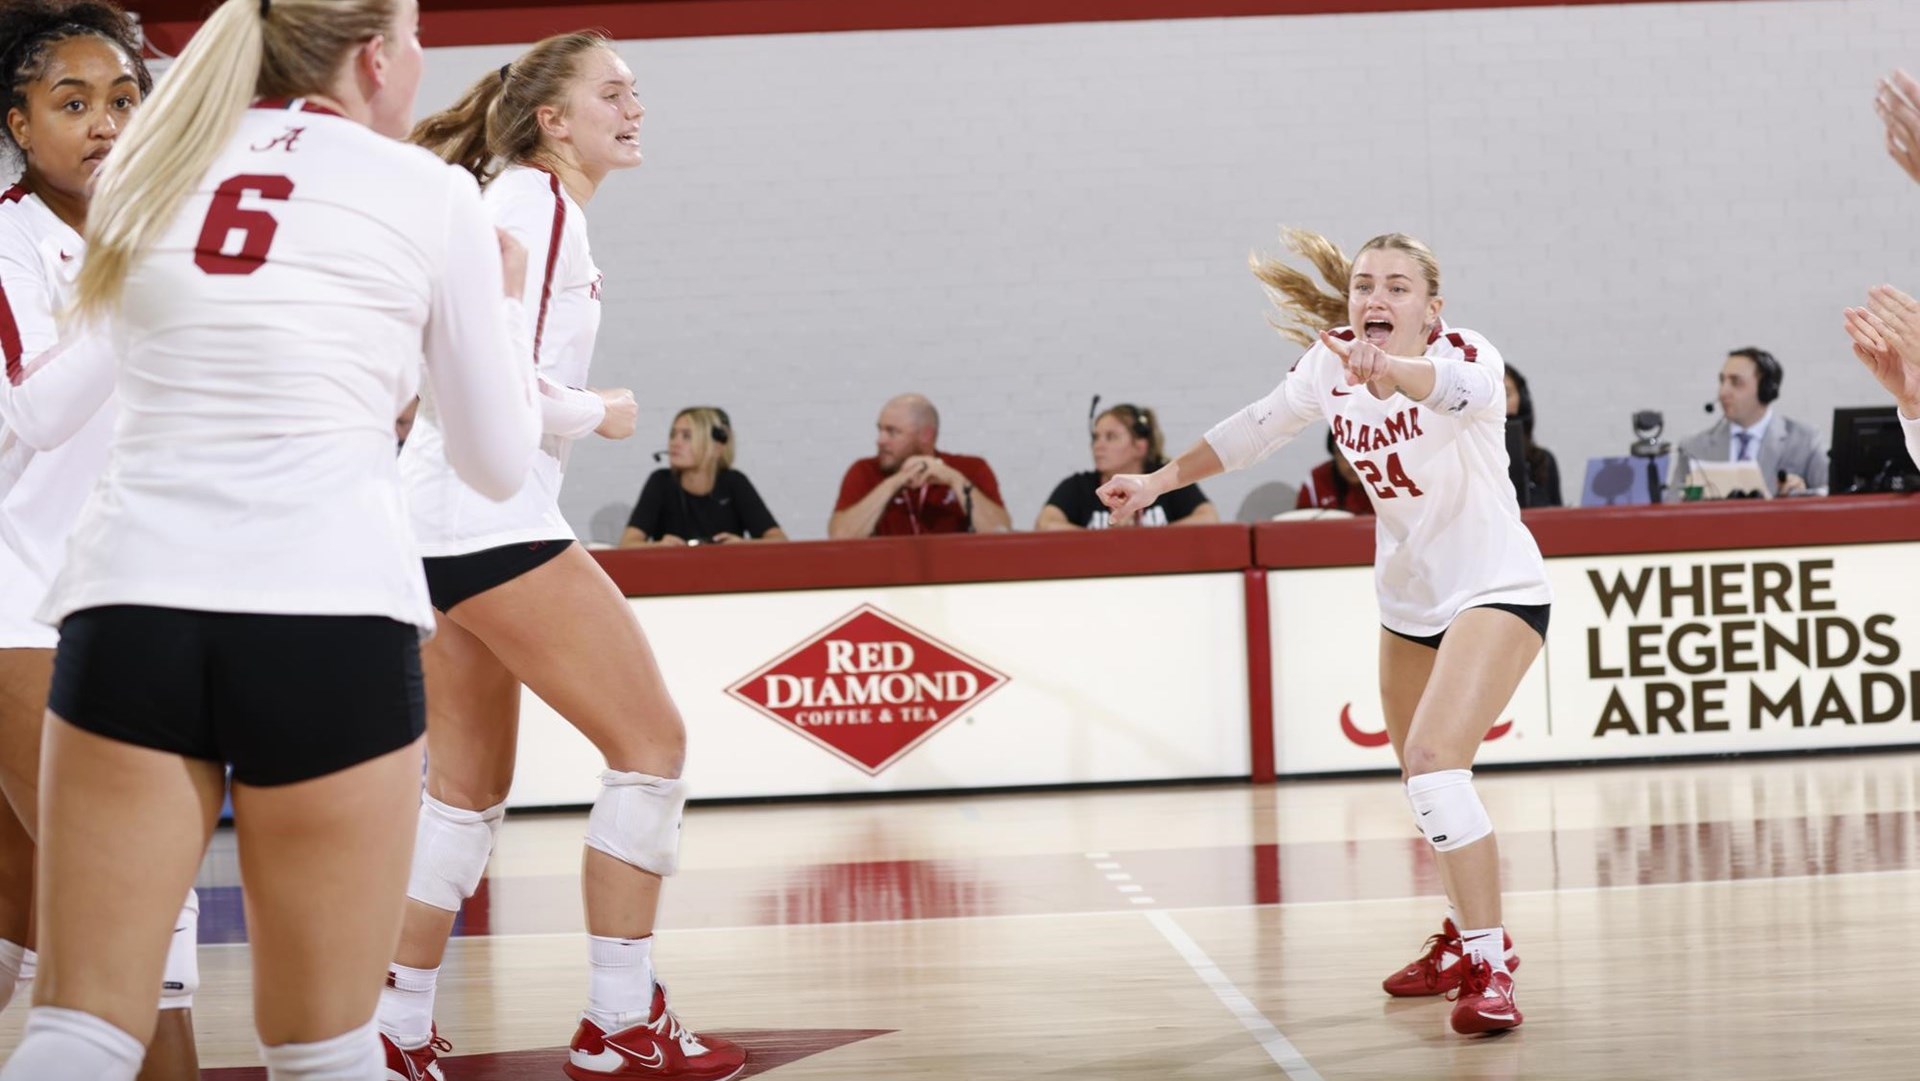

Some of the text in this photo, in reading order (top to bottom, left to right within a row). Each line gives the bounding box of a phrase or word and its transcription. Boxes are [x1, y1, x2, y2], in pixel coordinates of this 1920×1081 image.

[194, 174, 295, 275] 6
[1354, 451, 1424, 499] 24
[1586, 558, 1837, 620] WHERE
[825, 639, 915, 674] RED
[1586, 613, 1902, 680] LEGENDS
[764, 670, 978, 709] DIAMOND
[1592, 679, 1731, 737] ARE
[795, 706, 939, 727] COFFEE & TEA
